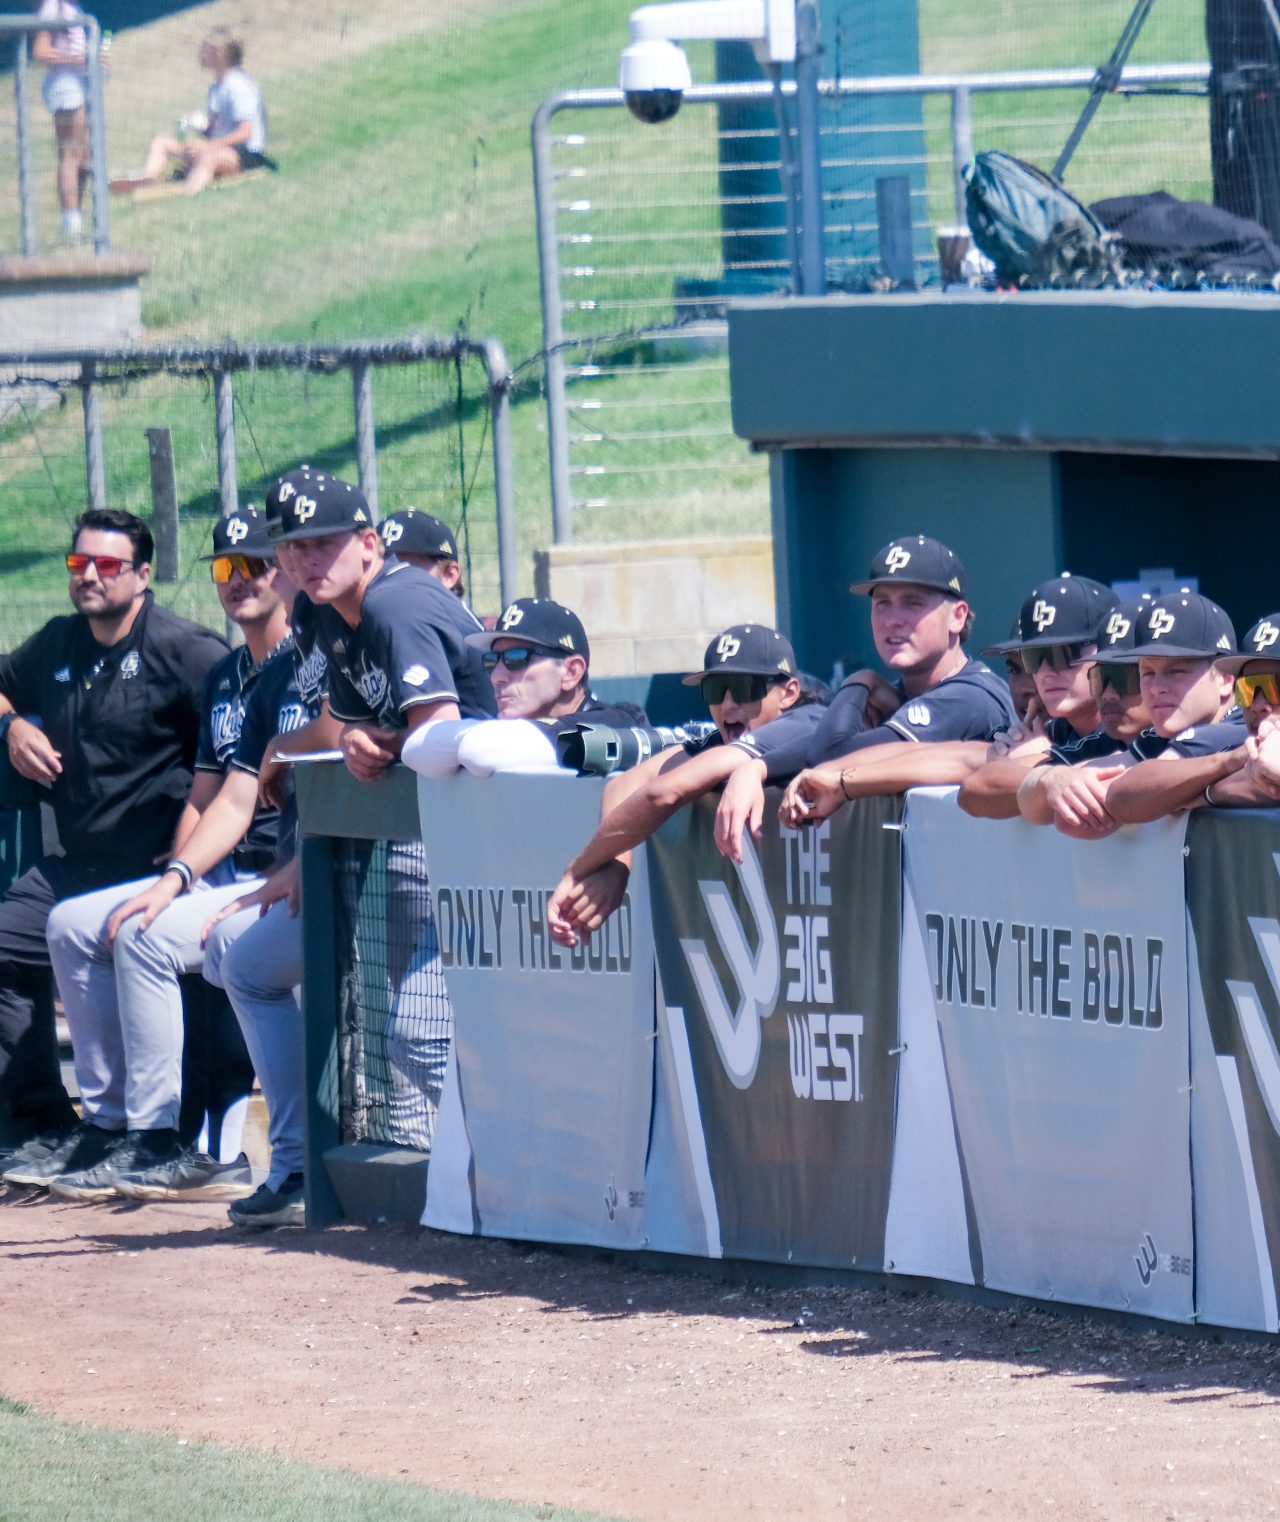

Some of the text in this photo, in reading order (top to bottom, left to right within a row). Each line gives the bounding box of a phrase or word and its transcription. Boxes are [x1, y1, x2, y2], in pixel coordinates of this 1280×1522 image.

[779, 819, 832, 906] THE
[437, 887, 504, 970] ONLY
[925, 912, 1164, 1031] ONLY THE BOLD
[787, 1013, 863, 1102] WEST
